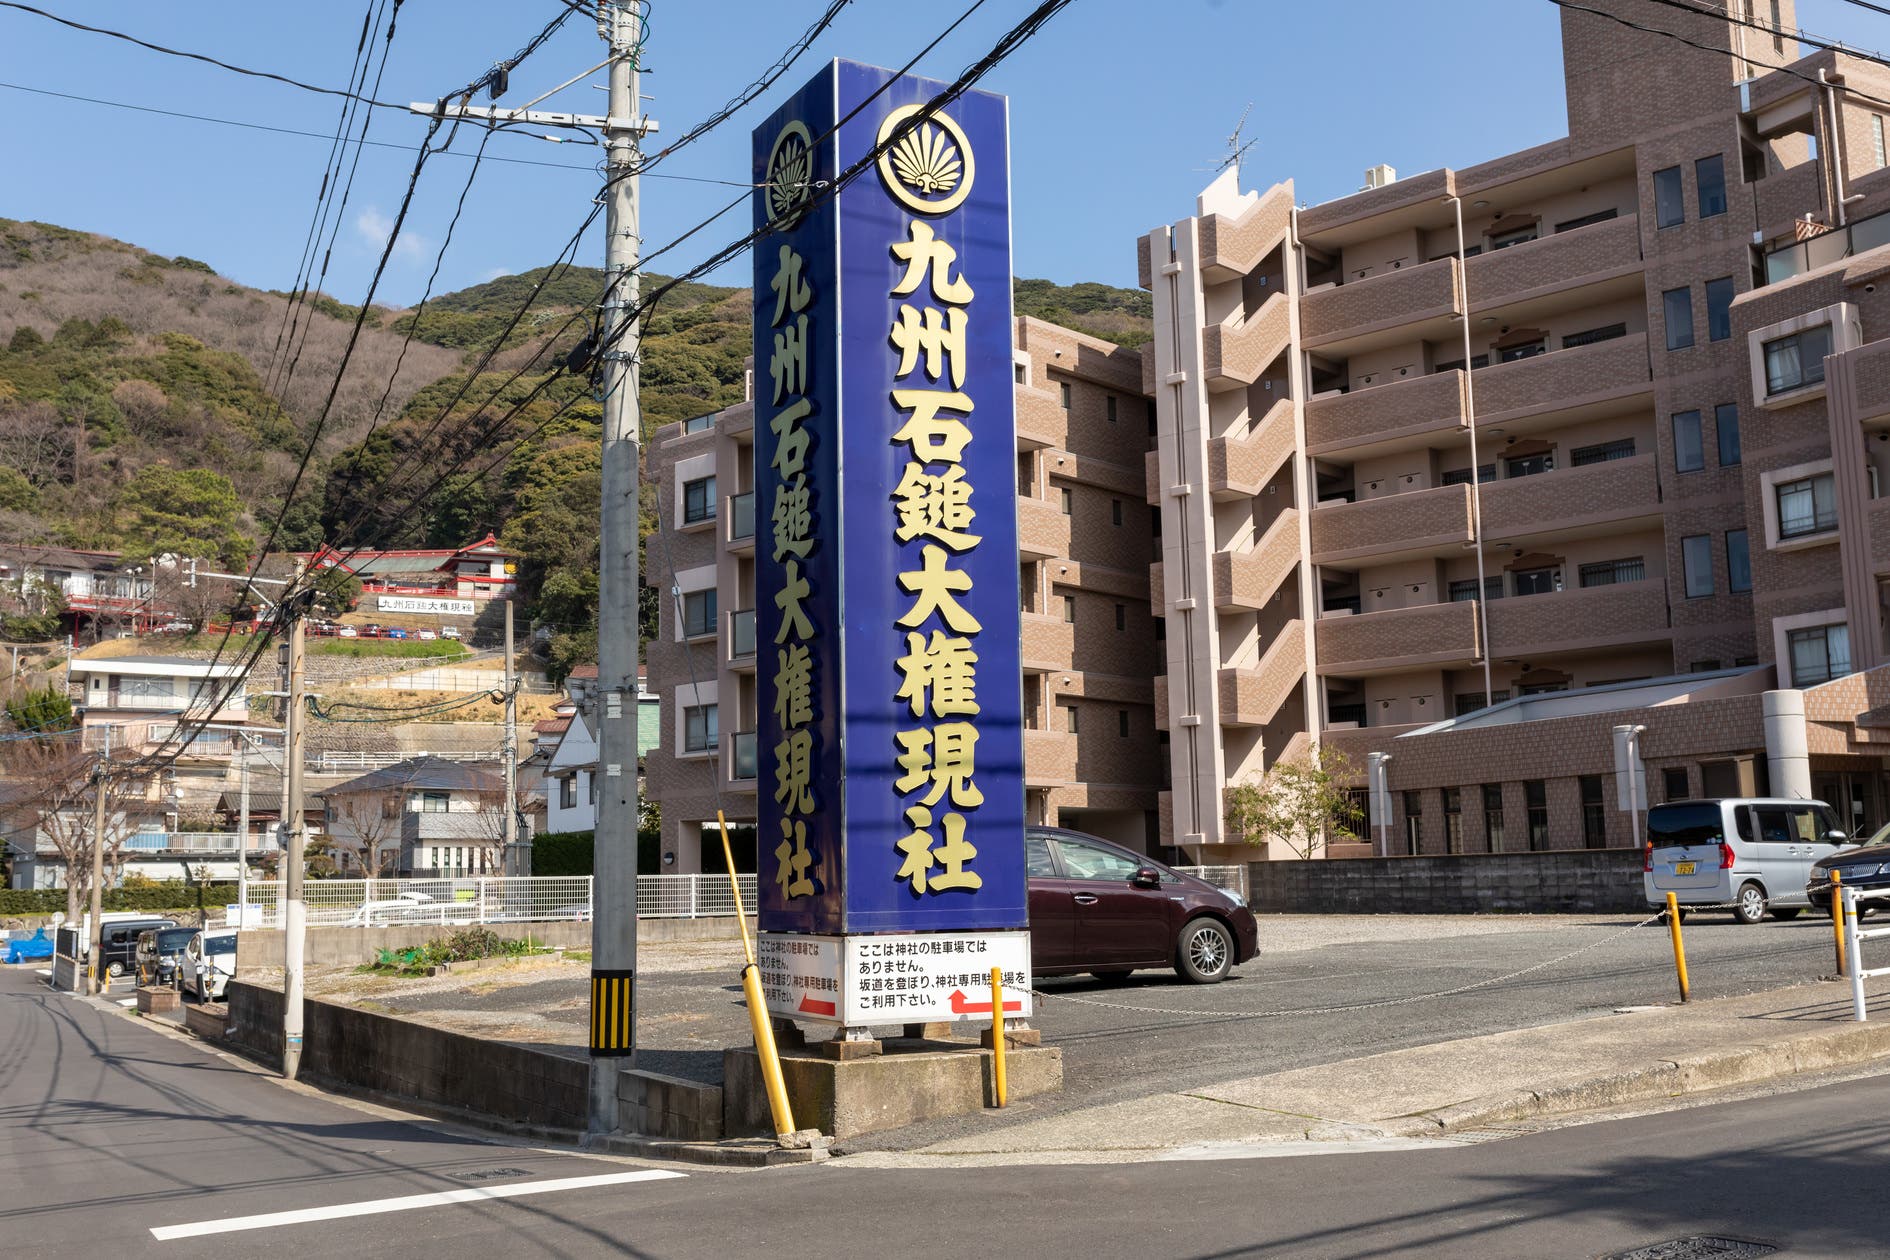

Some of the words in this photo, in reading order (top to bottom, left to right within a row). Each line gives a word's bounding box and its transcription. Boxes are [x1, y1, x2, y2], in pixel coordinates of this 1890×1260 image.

[889, 220, 984, 895] 九州石鎚大権現社
[770, 245, 815, 900] 九州石鎚大権現社
[859, 940, 987, 957] ここは神社の駐車場では
[859, 959, 924, 975] ありません。
[859, 971, 1026, 992] 坂道を登ぼり、神社専用駐場を
[763, 988, 794, 1003] 利用下さい。
[860, 993, 937, 1009] ご利用下さい。
